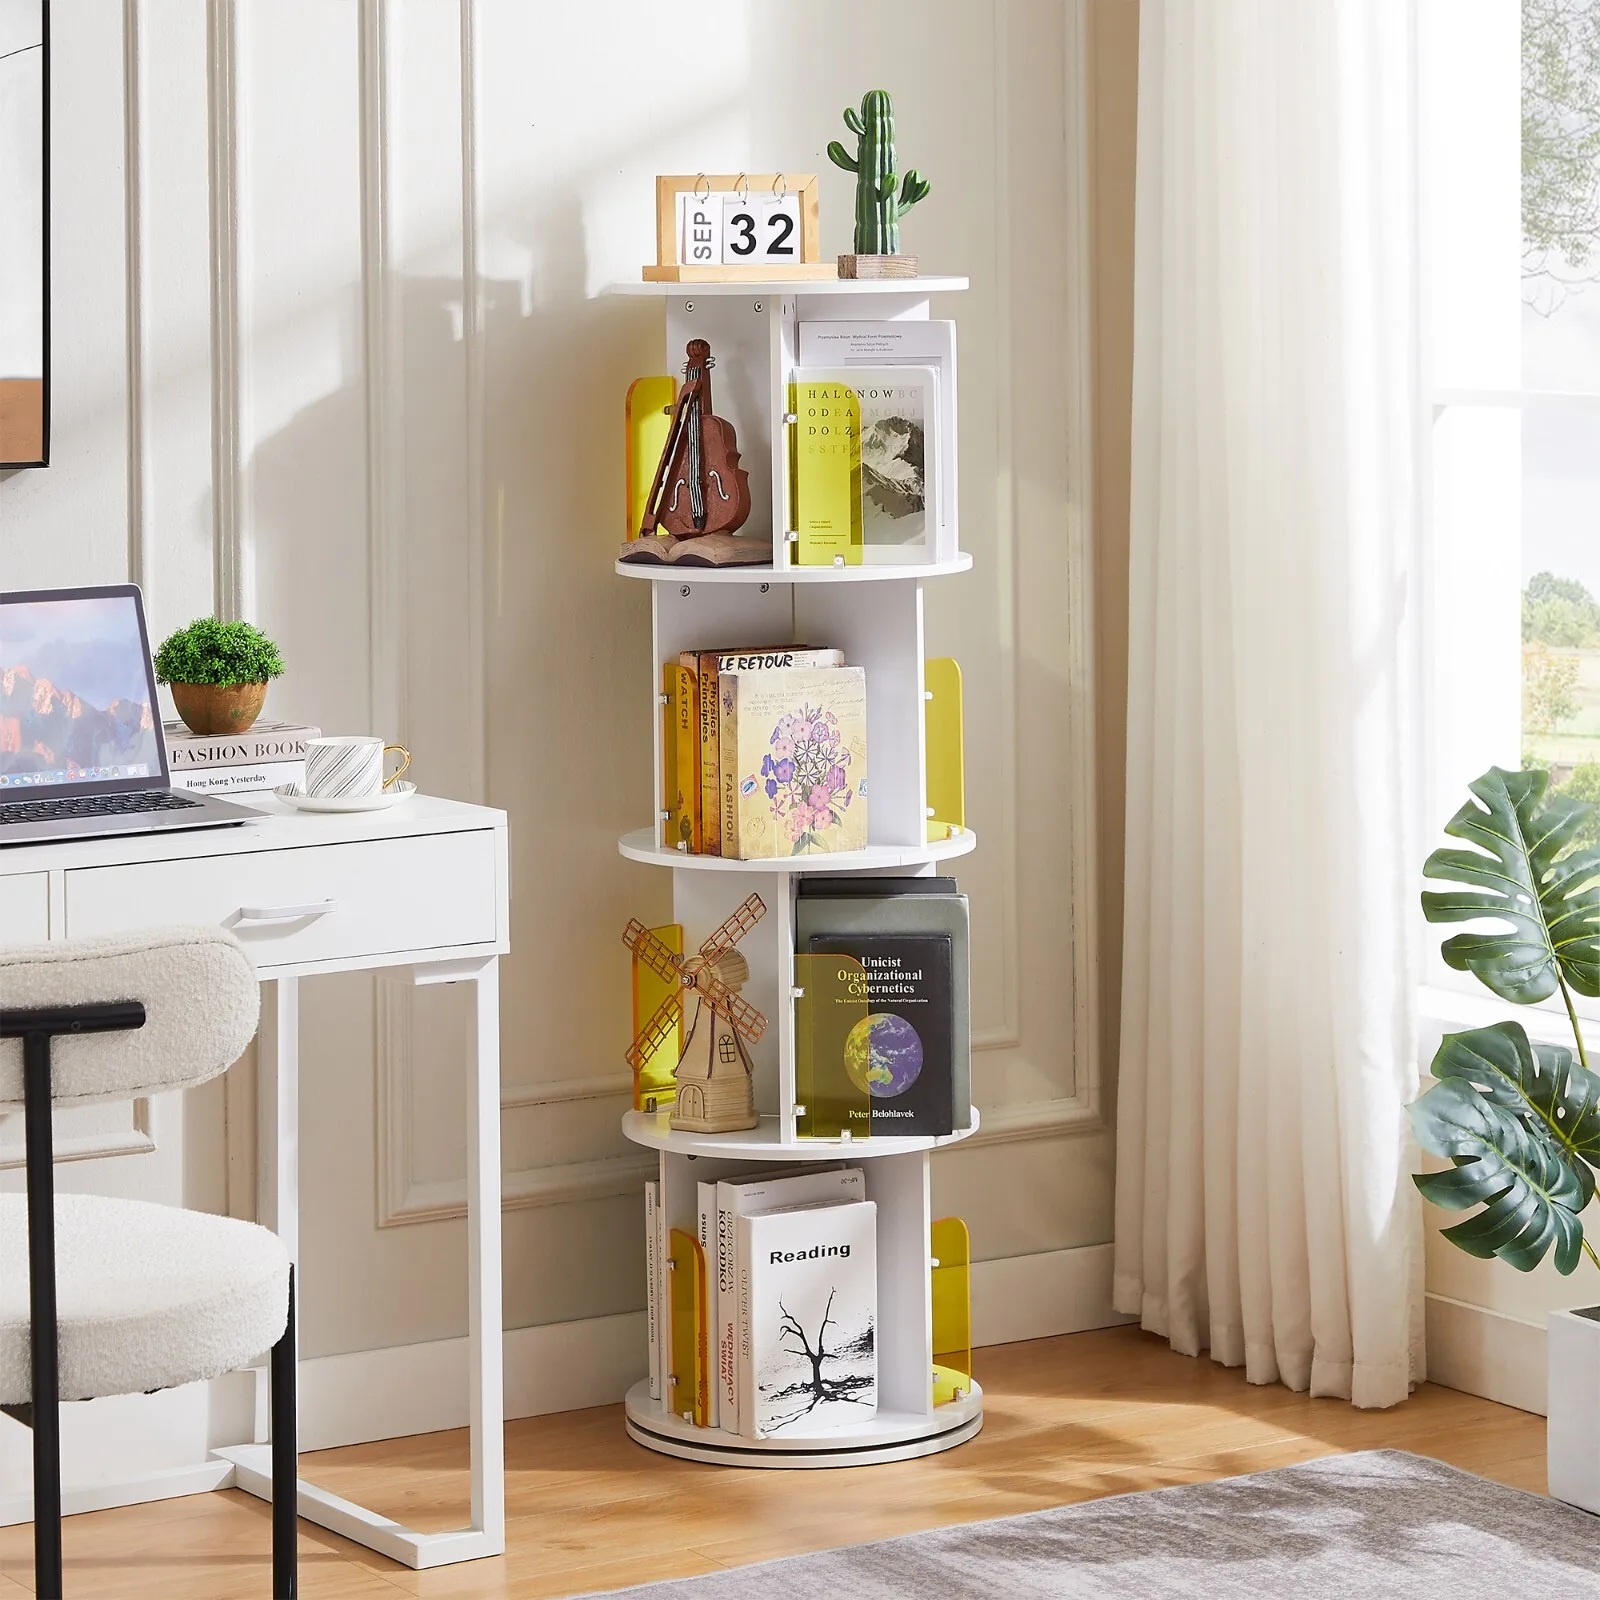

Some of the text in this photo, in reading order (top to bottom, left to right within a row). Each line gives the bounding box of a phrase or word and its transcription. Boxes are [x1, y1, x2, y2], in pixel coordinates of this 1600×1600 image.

[694, 212, 712, 260] SEP
[719, 656, 734, 672] LE
[737, 654, 794, 671] RETOUR
[701, 672, 709, 743] Principles
[709, 681, 717, 737] Physics
[255, 741, 305, 757] BOOK
[187, 774, 267, 788] Hong Kong Yesterday
[726, 773, 734, 843] FASHION
[861, 957, 902, 968] Unicist
[837, 969, 922, 983] Organizational
[848, 983, 915, 996] Cybernetics
[849, 1110, 869, 1118] Peter
[770, 1244, 851, 1265] Reading
